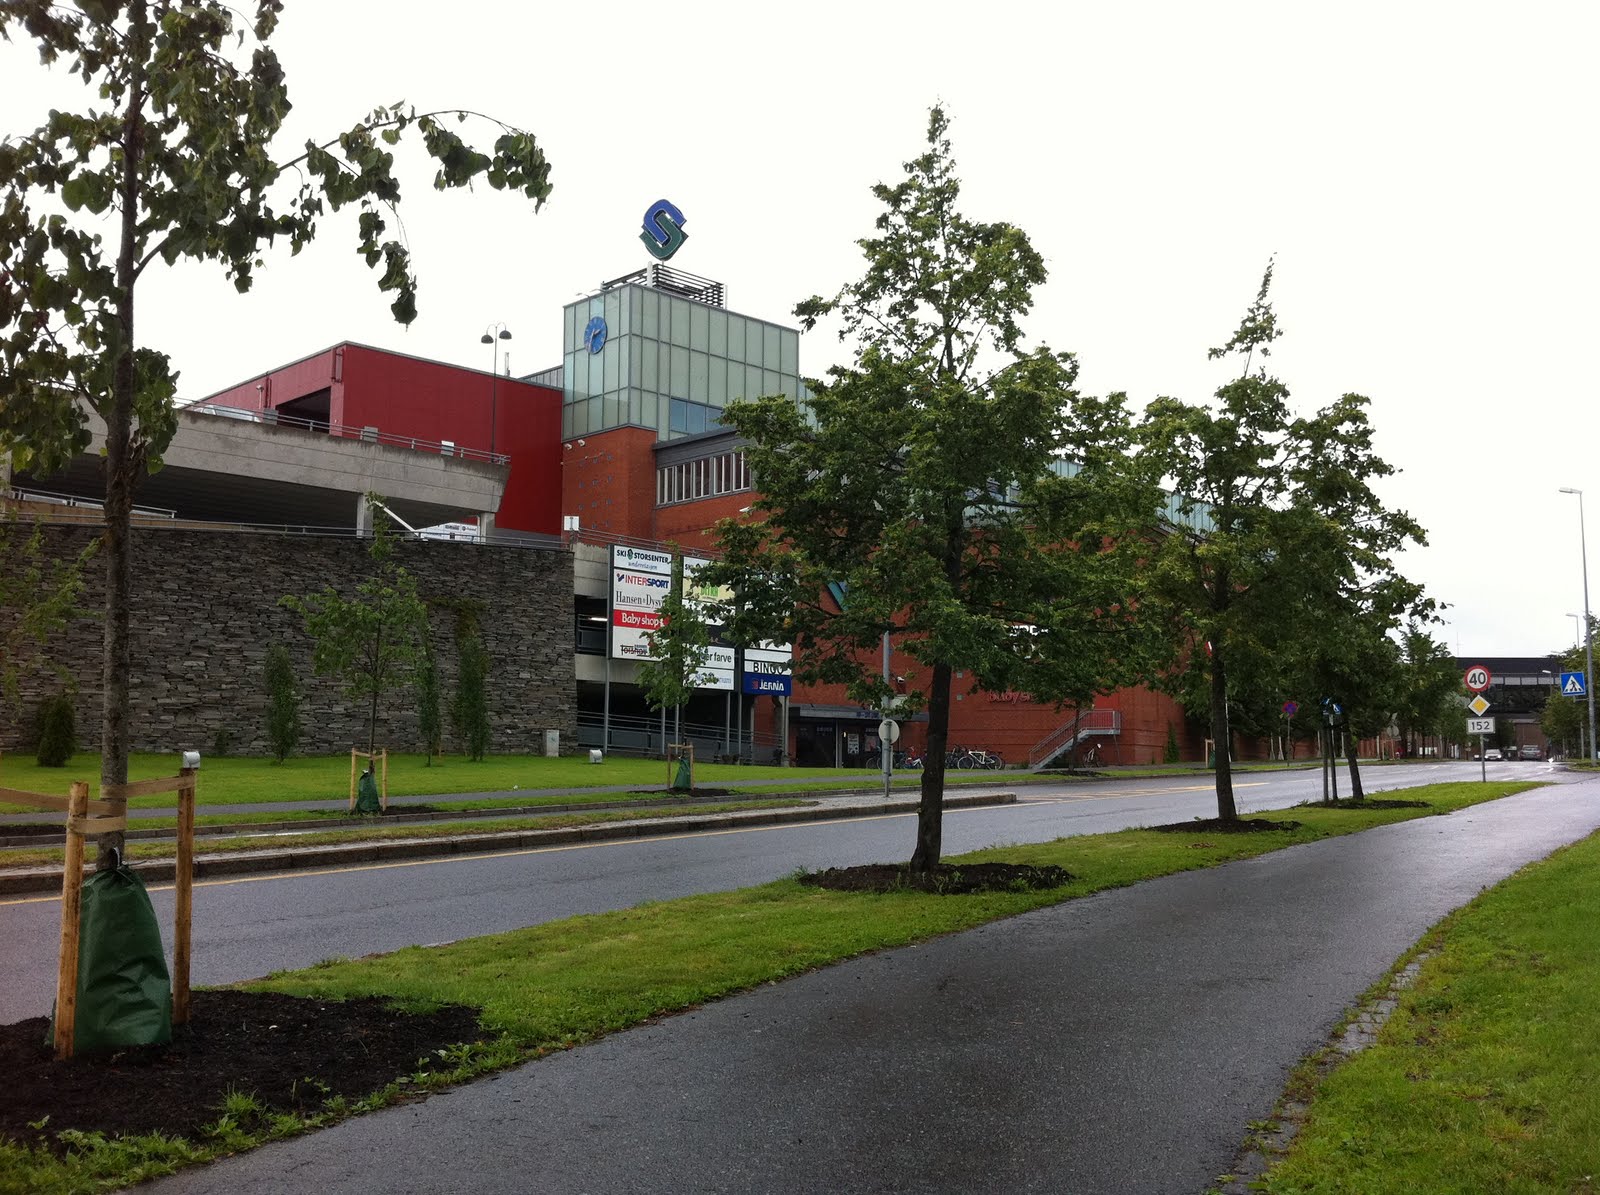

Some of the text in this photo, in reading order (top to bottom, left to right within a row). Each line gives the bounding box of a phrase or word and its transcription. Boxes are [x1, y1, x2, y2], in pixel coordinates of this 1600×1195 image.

[616, 549, 670, 564] SKI STORSENTER
[625, 574, 669, 589] INTERSPORT
[616, 590, 642, 605] Hansen
[621, 612, 660, 629] Baby shop
[714, 652, 732, 663] farve
[1469, 672, 1487, 685] 40
[1471, 721, 1490, 731] 152
